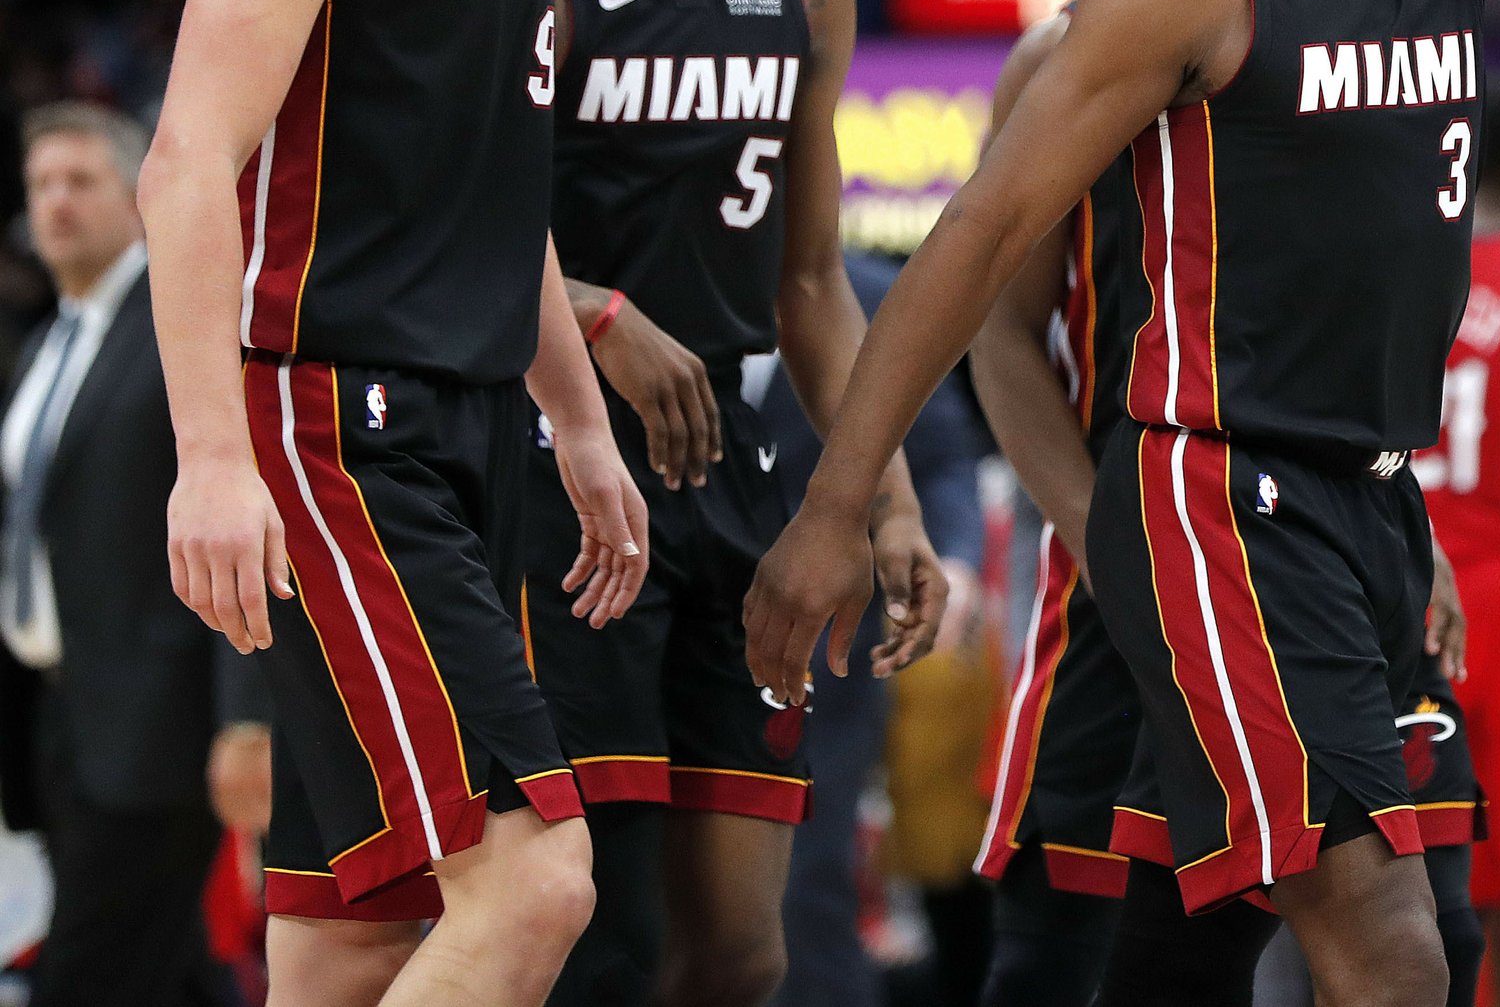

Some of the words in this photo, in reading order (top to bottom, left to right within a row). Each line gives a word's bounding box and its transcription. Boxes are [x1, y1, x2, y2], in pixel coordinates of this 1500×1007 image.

[576, 55, 800, 123] MIAMI
[1296, 30, 1477, 116] MIAMI
[718, 136, 784, 230] 5
[1436, 117, 1473, 222] 3
